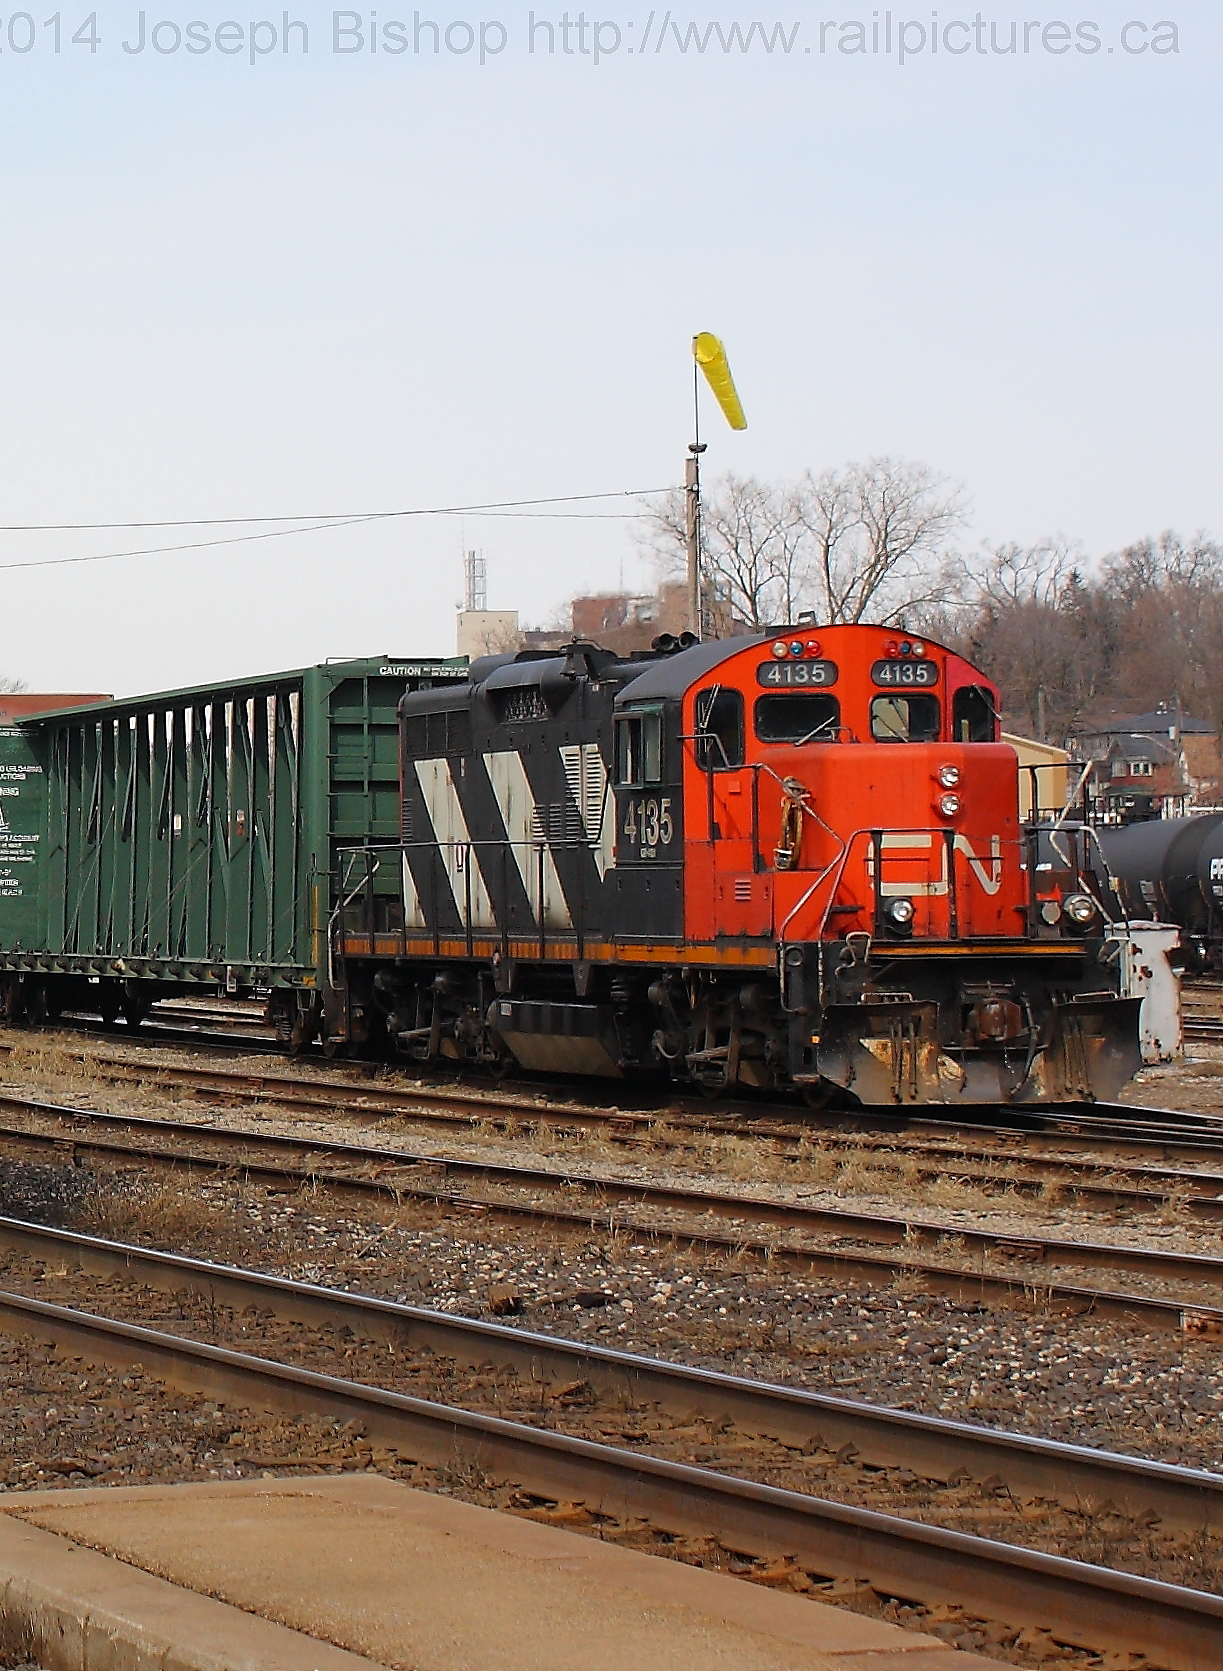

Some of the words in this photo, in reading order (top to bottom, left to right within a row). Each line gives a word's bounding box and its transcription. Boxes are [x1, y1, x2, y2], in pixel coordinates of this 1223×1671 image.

[379, 666, 411, 676] CAUTION
[767, 664, 825, 683] 4135
[879, 664, 928, 683] 4135
[624, 798, 673, 846] 4135
[866, 834, 1001, 896] CN
